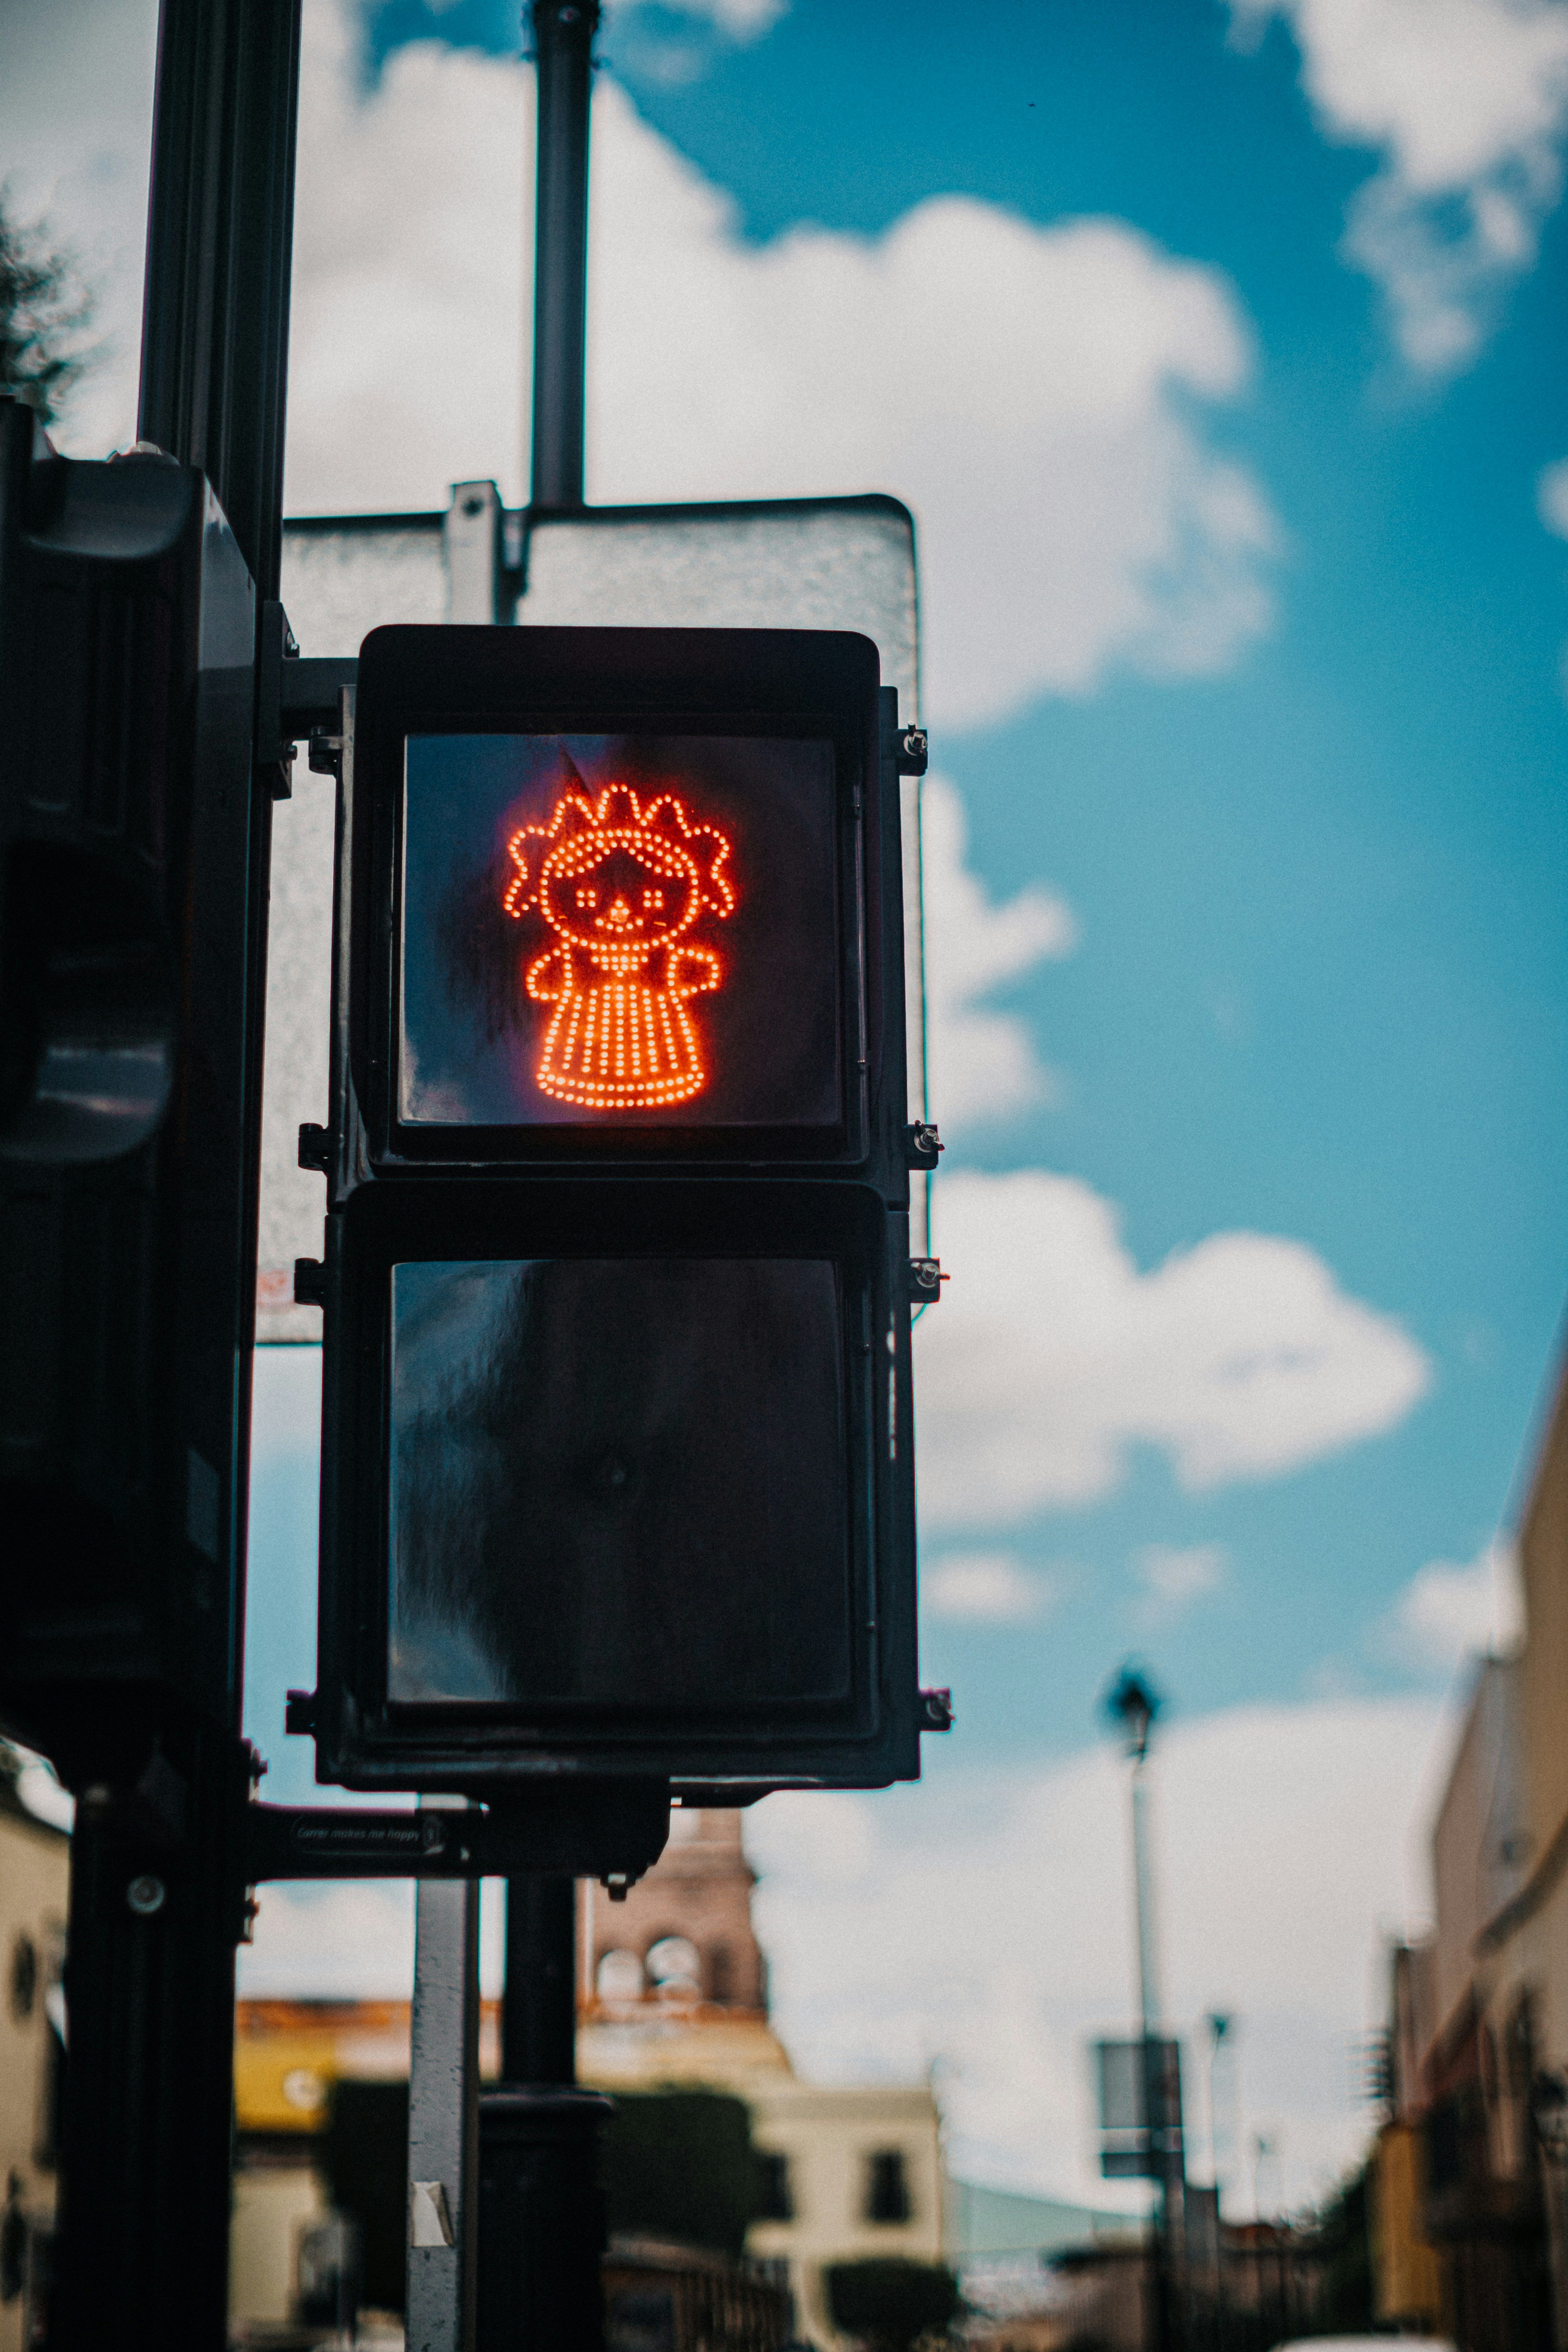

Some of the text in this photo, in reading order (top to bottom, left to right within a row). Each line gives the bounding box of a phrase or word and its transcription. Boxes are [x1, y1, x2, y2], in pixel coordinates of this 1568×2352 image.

[330, 1828, 365, 1838] makes
[368, 1830, 385, 1838] me
[387, 1828, 419, 1842] happy
